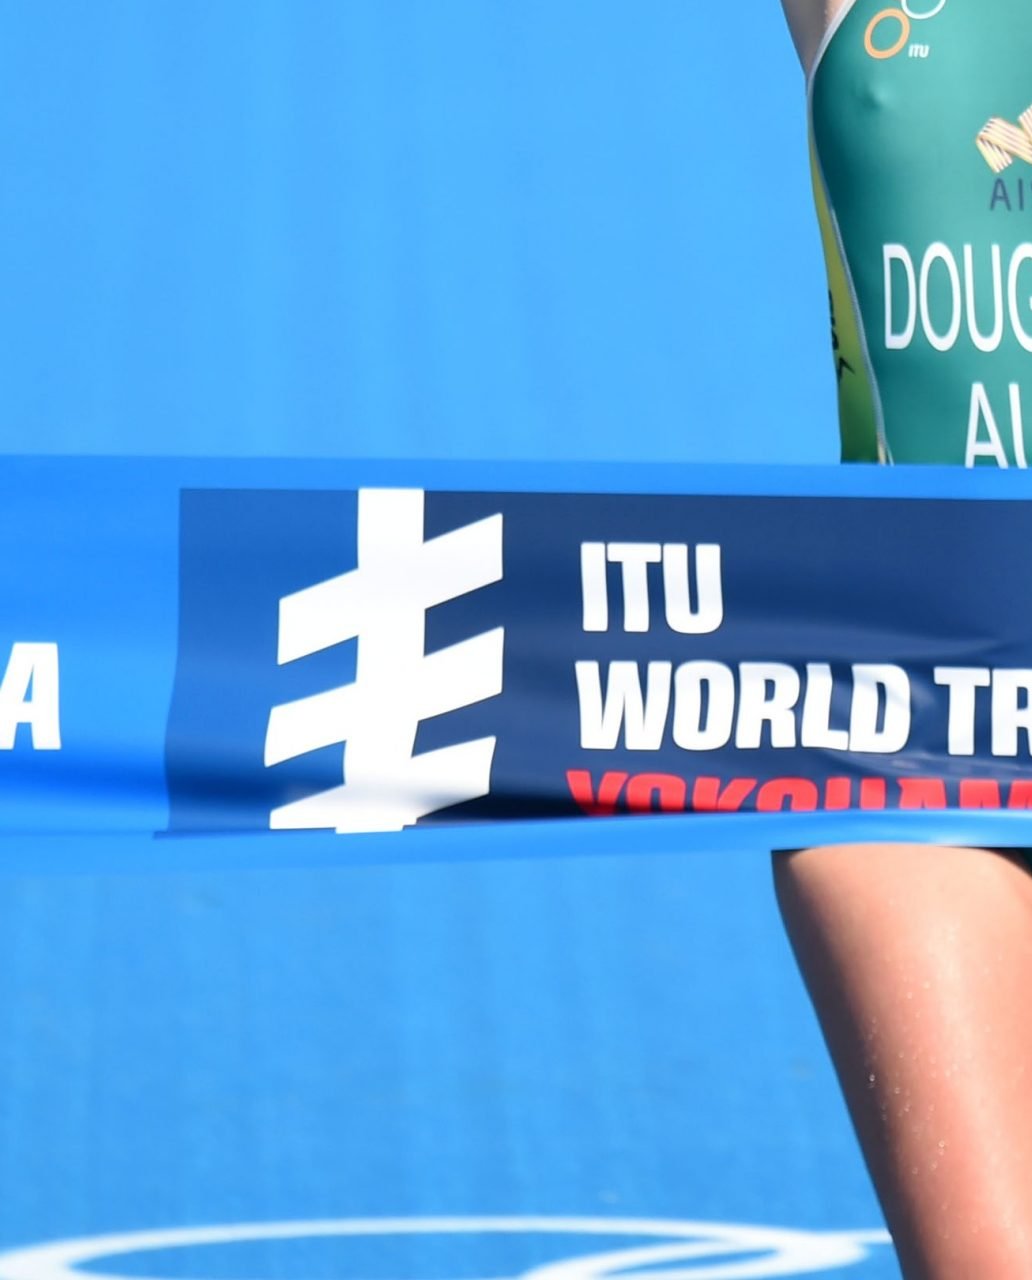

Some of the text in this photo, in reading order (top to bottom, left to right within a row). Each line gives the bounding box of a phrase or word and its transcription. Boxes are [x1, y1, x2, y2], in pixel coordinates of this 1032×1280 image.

[908, 44, 929, 58] ITU
[580, 541, 723, 634] ITU
[575, 660, 911, 754] WORLD
